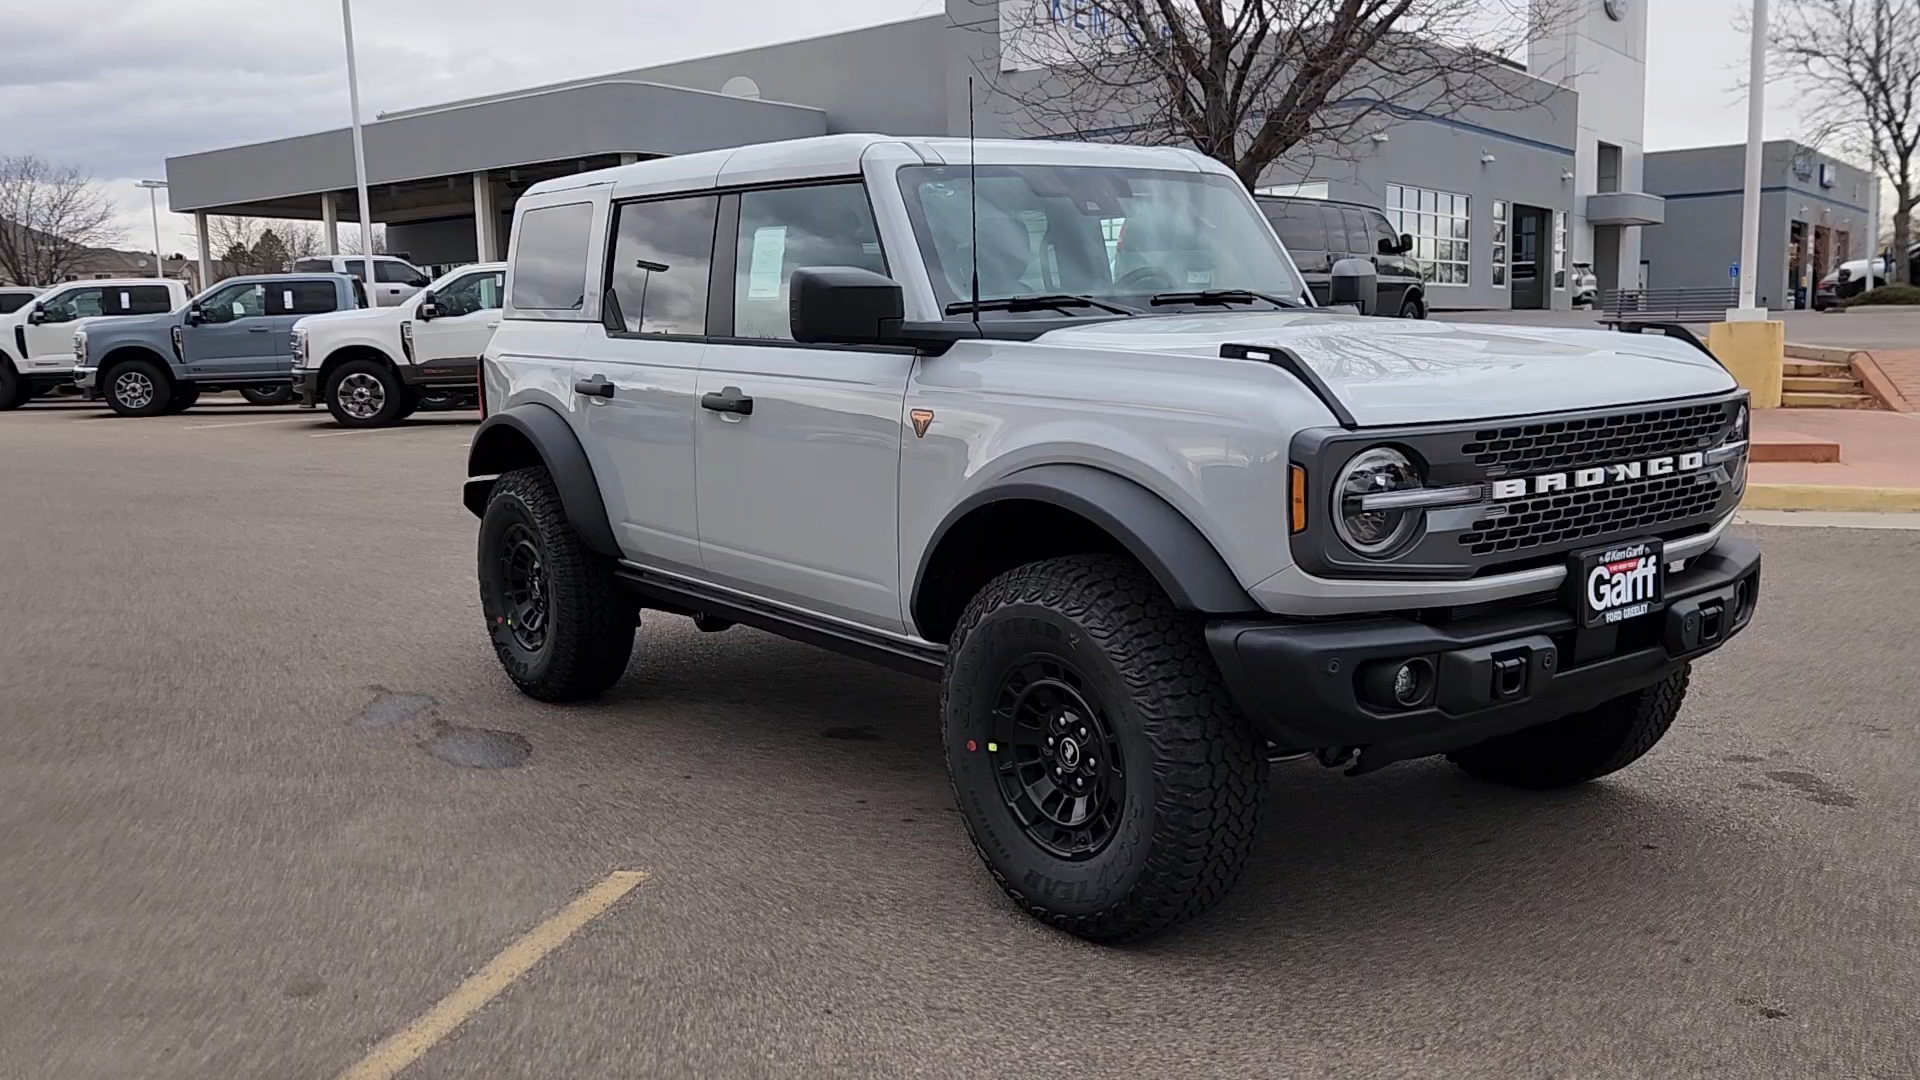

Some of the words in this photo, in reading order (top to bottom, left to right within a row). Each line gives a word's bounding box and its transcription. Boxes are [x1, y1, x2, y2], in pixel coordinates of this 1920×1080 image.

[1492, 452, 1703, 499] BRONCO
[1611, 549, 1626, 561] Ken
[1626, 544, 1645, 558] Garff
[1588, 555, 1657, 611] Garff
[1606, 610, 1623, 624] FORD
